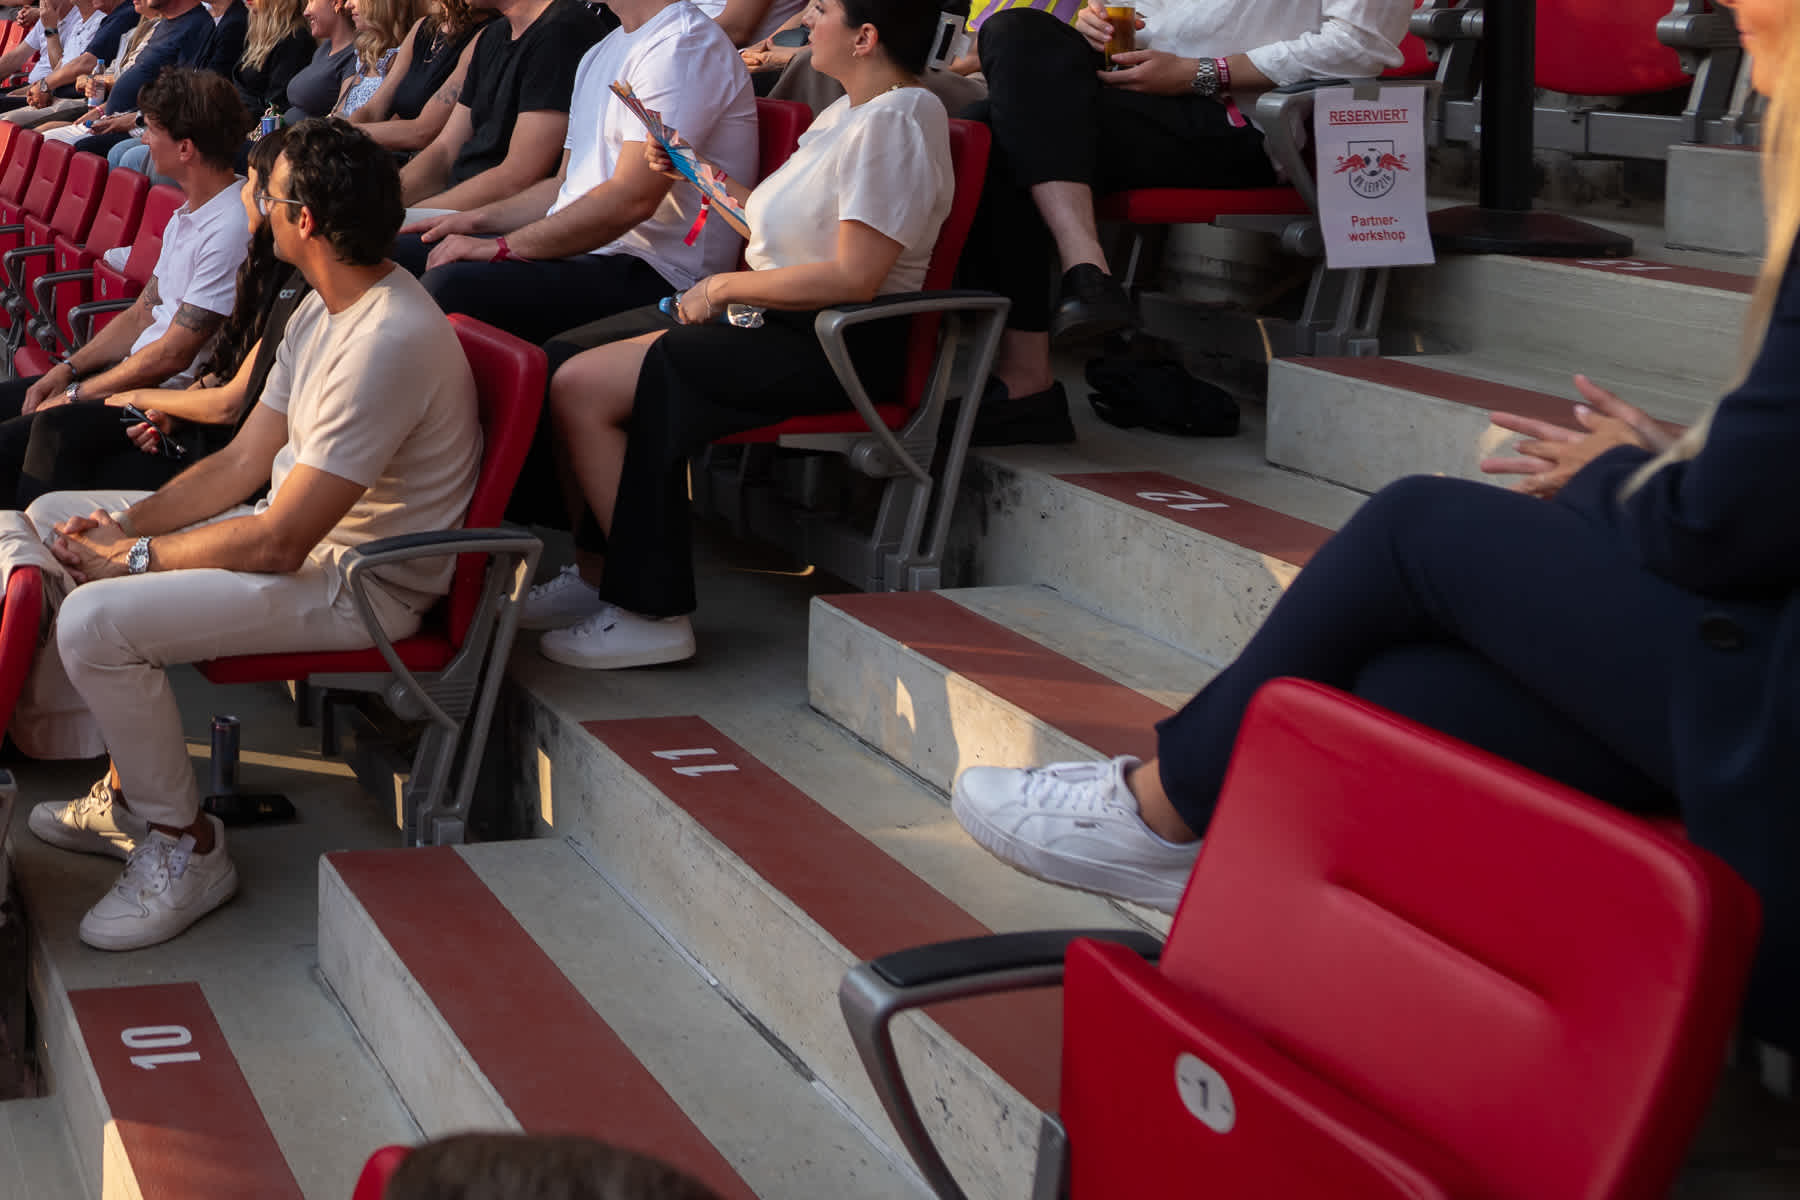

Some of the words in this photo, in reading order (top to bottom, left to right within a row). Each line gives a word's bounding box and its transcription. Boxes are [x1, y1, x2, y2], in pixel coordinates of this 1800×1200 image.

[1329, 109, 1409, 123] RESERVIERT
[1351, 215, 1399, 227] Partner-
[1348, 229, 1406, 243] workshop
[1136, 490, 1231, 511] 12
[651, 747, 741, 777] 11
[120, 1024, 201, 1071] 10
